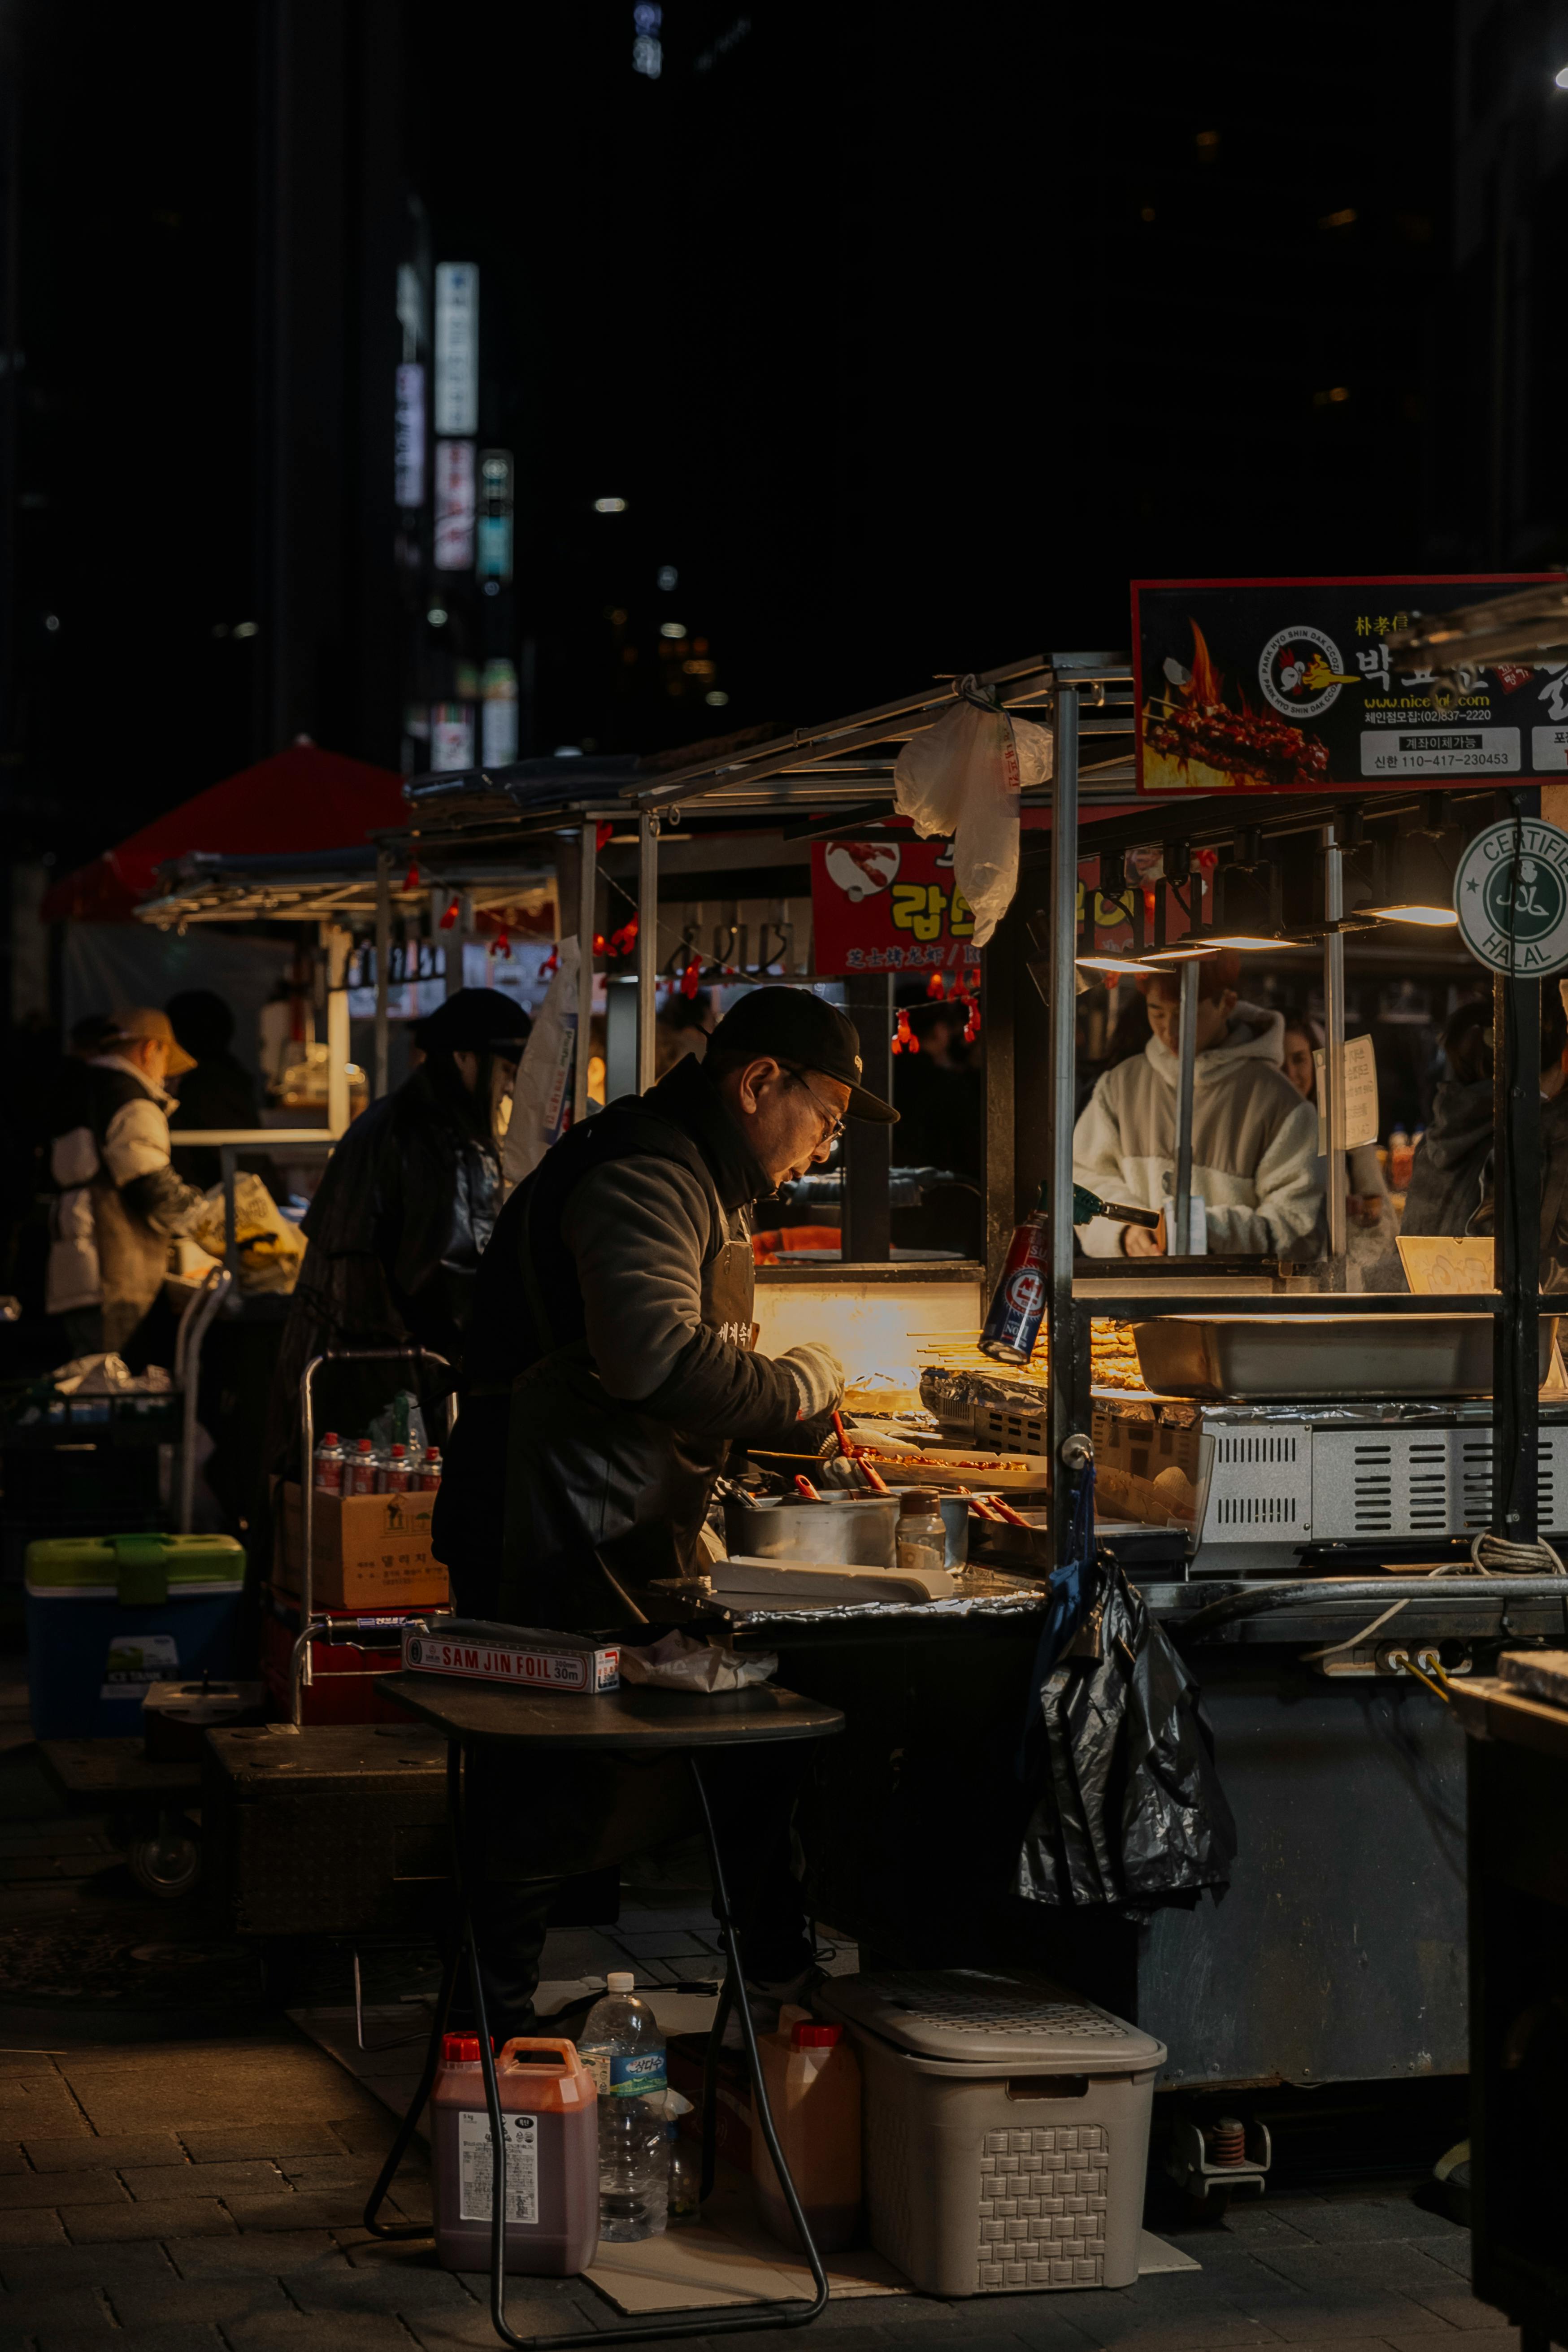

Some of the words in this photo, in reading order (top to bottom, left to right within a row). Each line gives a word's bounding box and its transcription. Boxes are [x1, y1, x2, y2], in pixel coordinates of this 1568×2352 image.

[1262, 650, 1273, 674] PARK
[1271, 635, 1286, 649] HYO
[1288, 630, 1308, 638] SHIN
[1310, 632, 1327, 646] DAK
[1264, 678, 1276, 699] PARK
[1275, 698, 1289, 710] HYO
[1290, 705, 1309, 714] SHIN
[1311, 700, 1325, 712] DAK
[1325, 683, 1339, 702] CCO
[1406, 736, 1477, 750] 계좌이체가능
[1374, 755, 1398, 769] 신한
[1402, 753, 1508, 767] 110-417-230453
[1483, 830, 1568, 884] CERTIFIE
[443, 1646, 478, 1669] SAM
[484, 1652, 511, 1674] JIN
[517, 1656, 551, 1678] FOIL
[555, 1660, 578, 1669] 300mm
[554, 1667, 578, 1680] 30m
[631, 2056, 662, 2074] 삼다수
